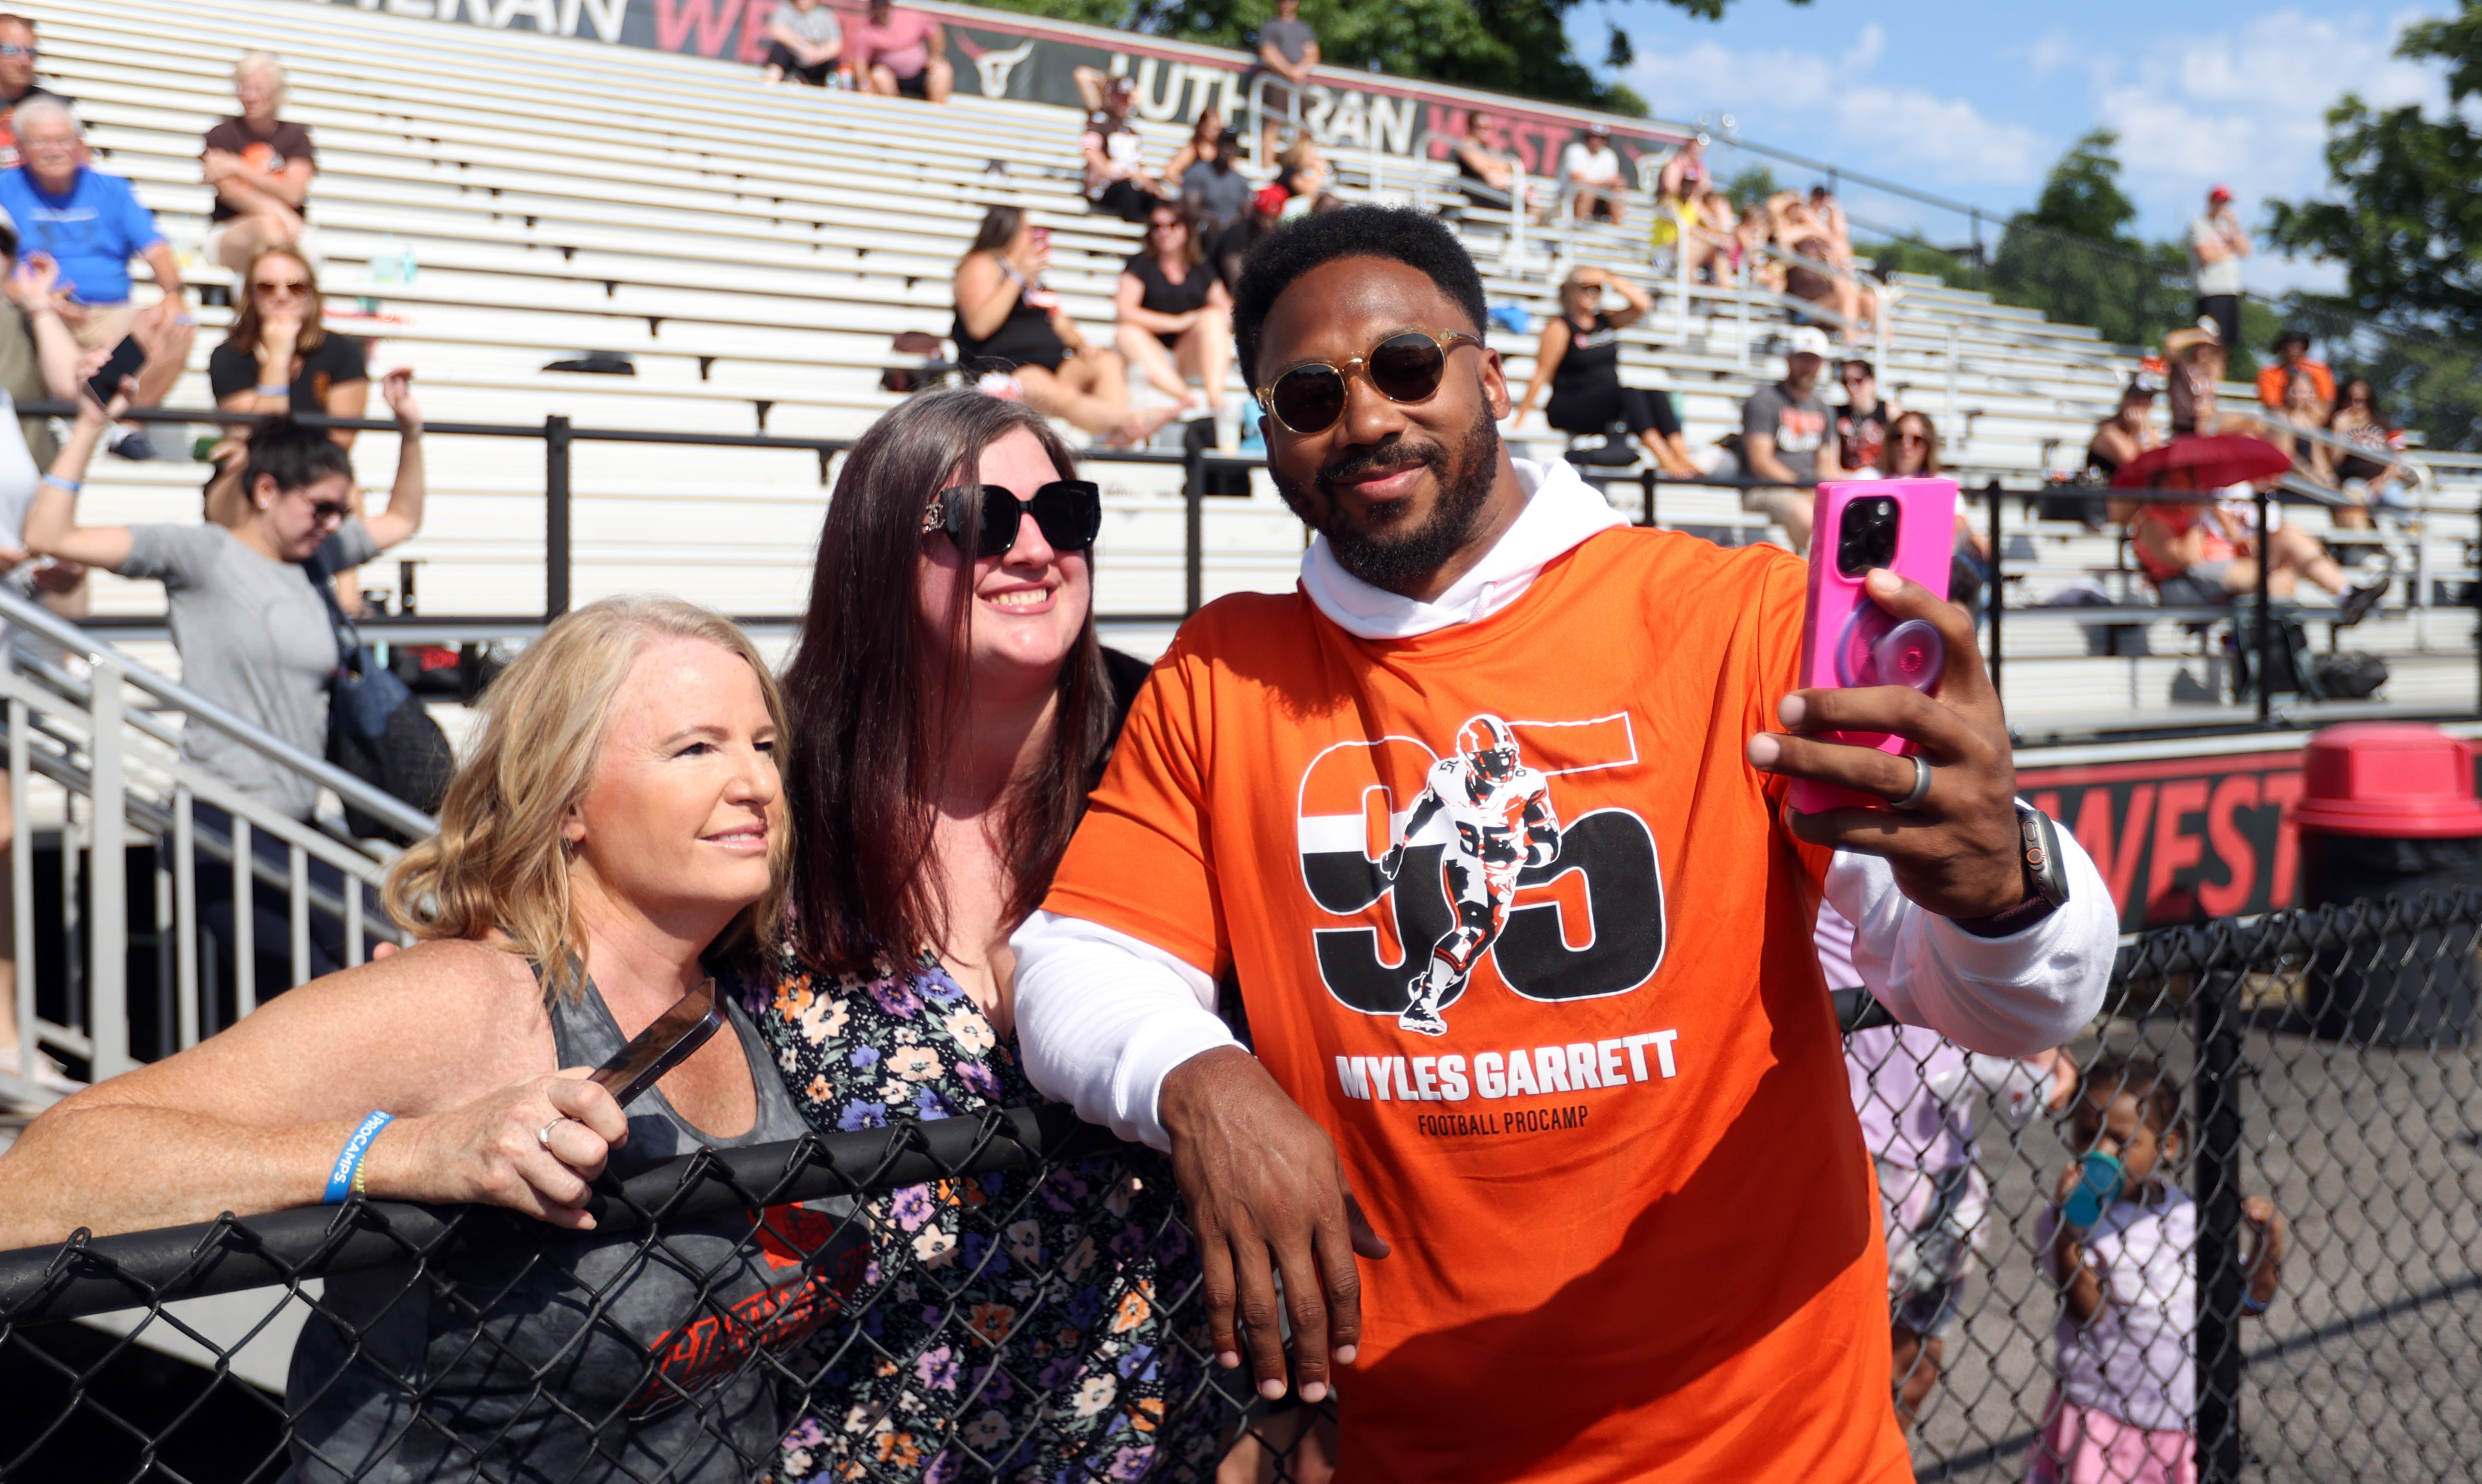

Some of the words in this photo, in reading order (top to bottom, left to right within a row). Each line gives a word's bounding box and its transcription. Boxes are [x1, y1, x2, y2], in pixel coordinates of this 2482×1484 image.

[1297, 711, 1666, 1015] 95
[1335, 1055, 1470, 1101] MYLES
[1473, 1029, 1678, 1099] GARRETT
[334, 1115, 385, 1184] PROCAMPS
[1417, 1114, 1500, 1136] FOOTBALL
[1504, 1105, 1589, 1133] PROCAMP
